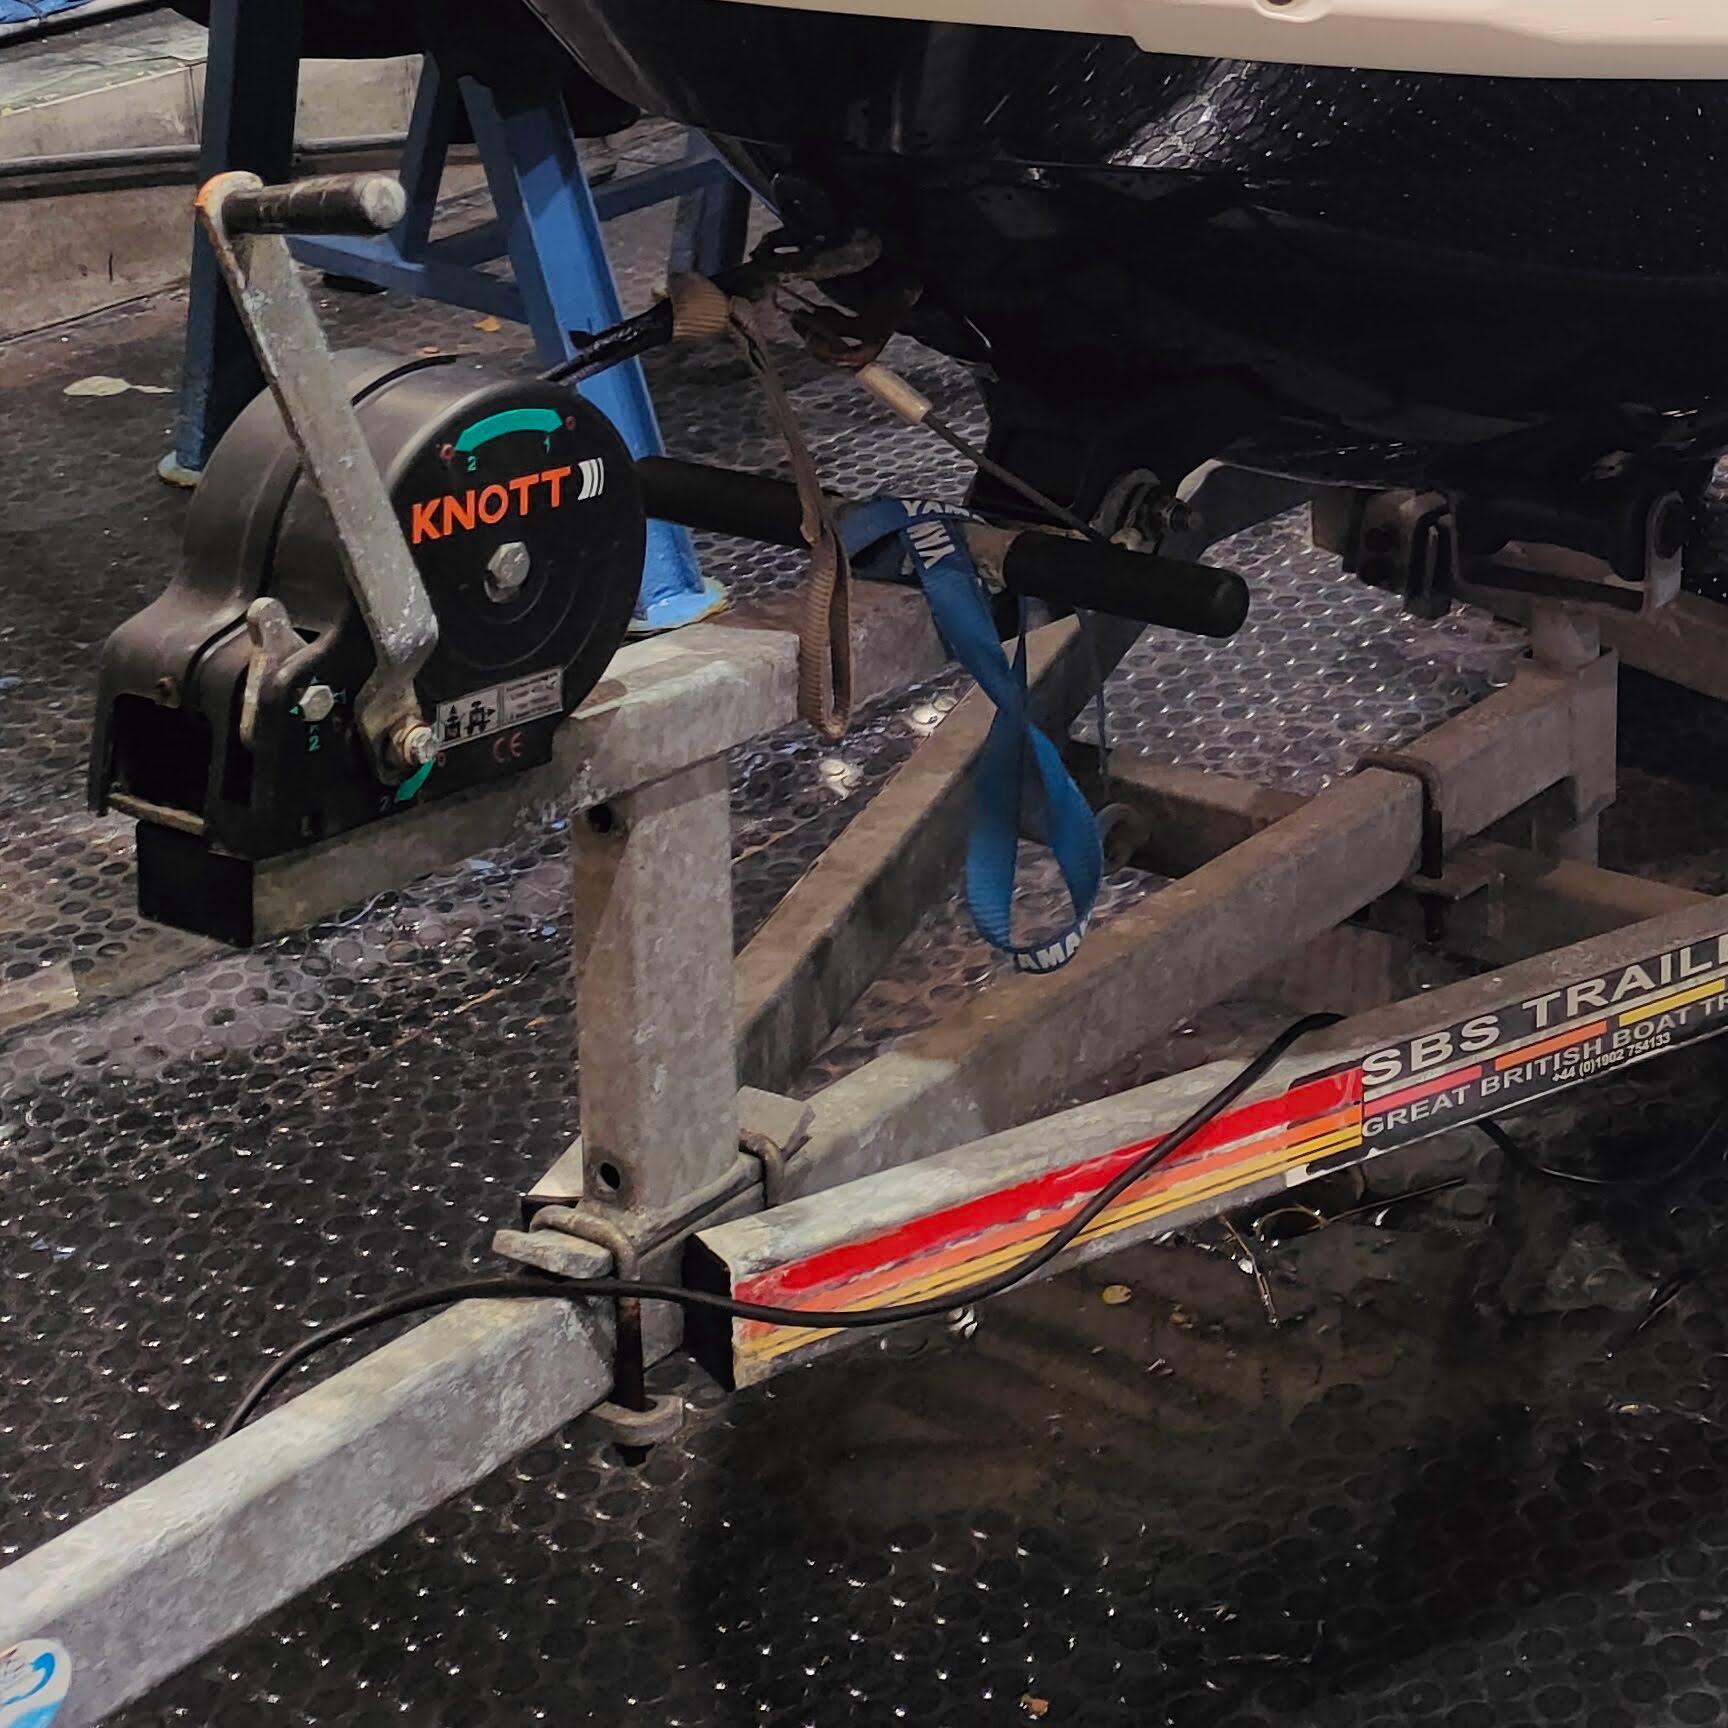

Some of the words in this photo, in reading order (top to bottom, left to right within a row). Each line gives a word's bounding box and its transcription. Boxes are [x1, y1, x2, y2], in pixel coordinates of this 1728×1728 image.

[411, 465, 572, 545] KNOTT
[1362, 1014, 1501, 1087] SBS
[1362, 1085, 1471, 1139] GREAT
[1481, 1037, 1603, 1098] BRITISH
[1612, 1006, 1694, 1051] BOAT
